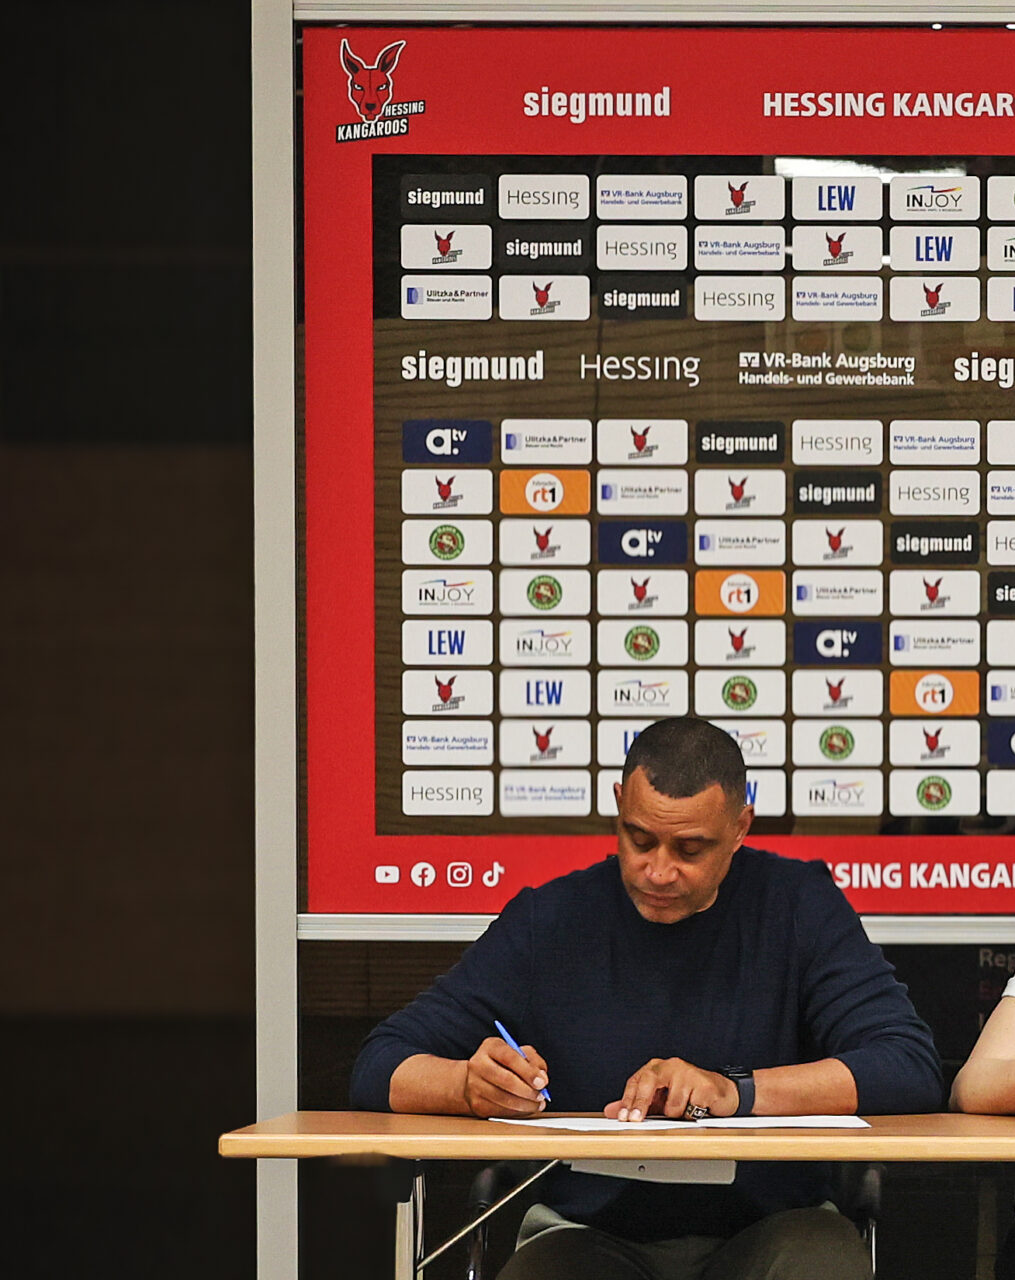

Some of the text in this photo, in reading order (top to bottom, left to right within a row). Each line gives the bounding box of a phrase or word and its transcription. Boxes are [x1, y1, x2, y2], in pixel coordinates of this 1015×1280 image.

[384, 100, 425, 116] HESSING
[524, 87, 669, 123] siegmund
[764, 93, 884, 116] HESSING
[337, 117, 408, 141] KANGAROOS
[408, 188, 483, 208] siegmund
[508, 190, 579, 209] Hessing
[818, 186, 855, 211] LEW
[907, 194, 962, 207] INJOY
[507, 239, 581, 259] siegmund
[606, 241, 676, 260] Hessing
[744, 242, 780, 250] Augsburg
[916, 236, 953, 261] LEW
[604, 290, 679, 310] siegmund
[704, 292, 774, 310] Hessing
[402, 351, 543, 387] siegmund
[581, 355, 700, 387] Hessing
[763, 352, 914, 372] VR-Bank Augsburg
[739, 371, 914, 385] Handels- und Gewerbebank
[702, 434, 777, 454] siegmund
[801, 436, 871, 454] Hessing
[533, 487, 557, 503] rt1
[800, 484, 874, 505] siegmund
[899, 487, 969, 504] Hessing
[897, 534, 971, 555] siegmund
[419, 588, 473, 601] INJOY
[728, 589, 752, 604] rt1
[429, 630, 465, 655] LEW
[517, 637, 571, 651] INJOY
[527, 681, 562, 705] LEW
[614, 689, 668, 701] INJOY
[923, 689, 947, 704] rt1
[412, 787, 482, 804] Hessing
[809, 788, 863, 802] INJOY
[827, 862, 902, 889] SING
